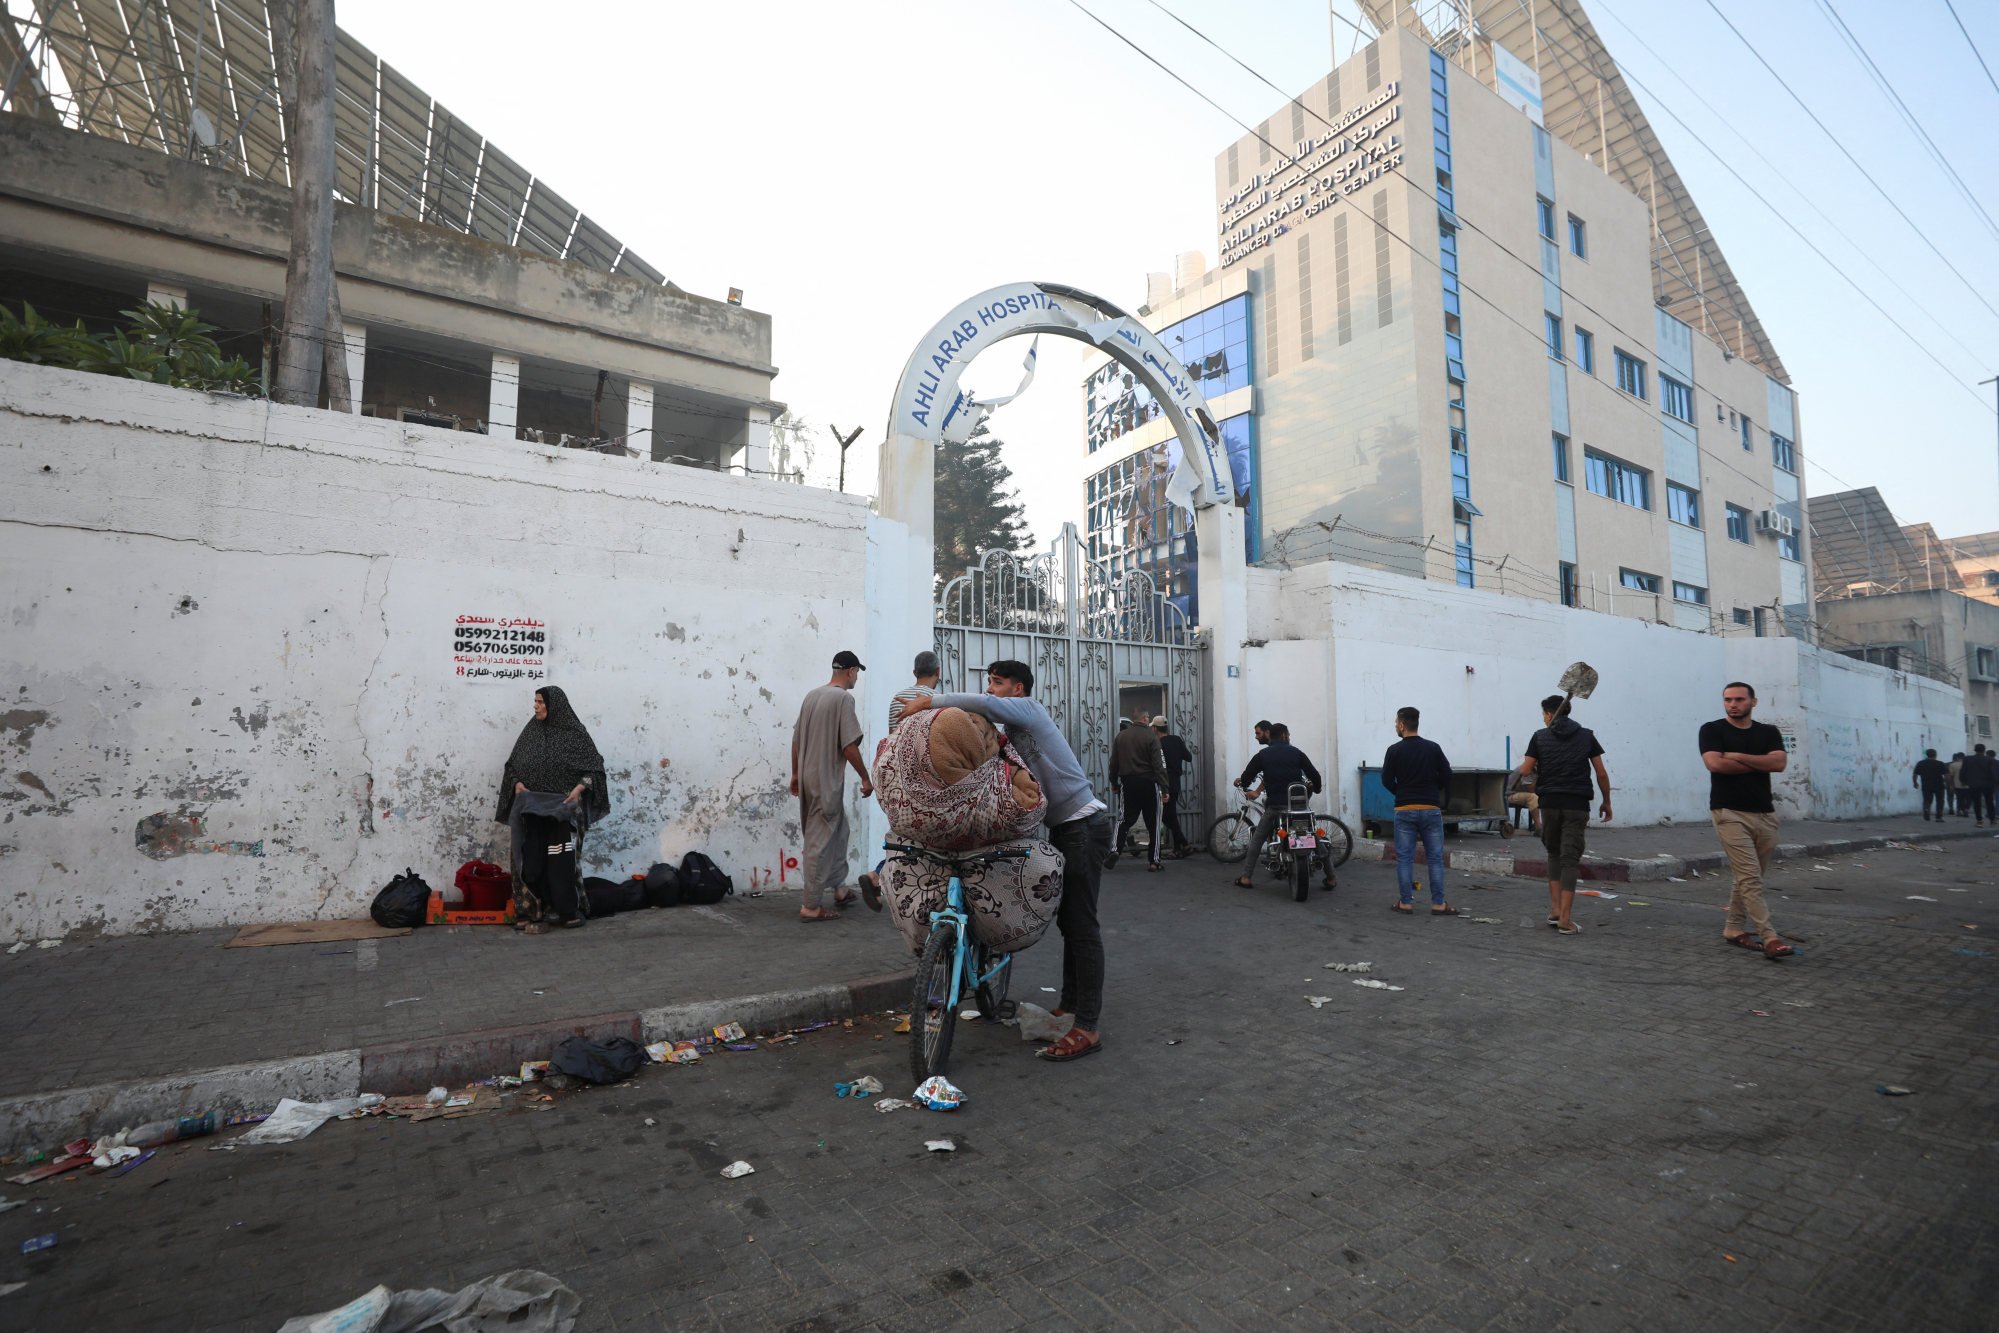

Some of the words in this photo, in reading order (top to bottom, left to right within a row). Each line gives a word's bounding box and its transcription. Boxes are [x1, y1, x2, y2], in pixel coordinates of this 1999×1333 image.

[1352, 105, 1398, 151] المركز
[1270, 139, 1345, 201] التشخيصي
[1220, 233, 1268, 269] ADVANCED
[1343, 154, 1401, 195] CENTER
[1220, 191, 1266, 235] المتطور
[1220, 224, 1252, 254] AHLI
[1256, 193, 1303, 232] ARAB
[911, 370, 940, 427] AHLI
[932, 319, 978, 373] ARAB
[977, 293, 1065, 327] HOSPITA
[455, 627, 545, 642] 0599212148
[456, 615, 494, 626] سعدي
[454, 641, 544, 655] 0567065090
[505, 656, 520, 664] على
[523, 656, 542, 665] خدمة
[528, 669, 544, 680] غزة
